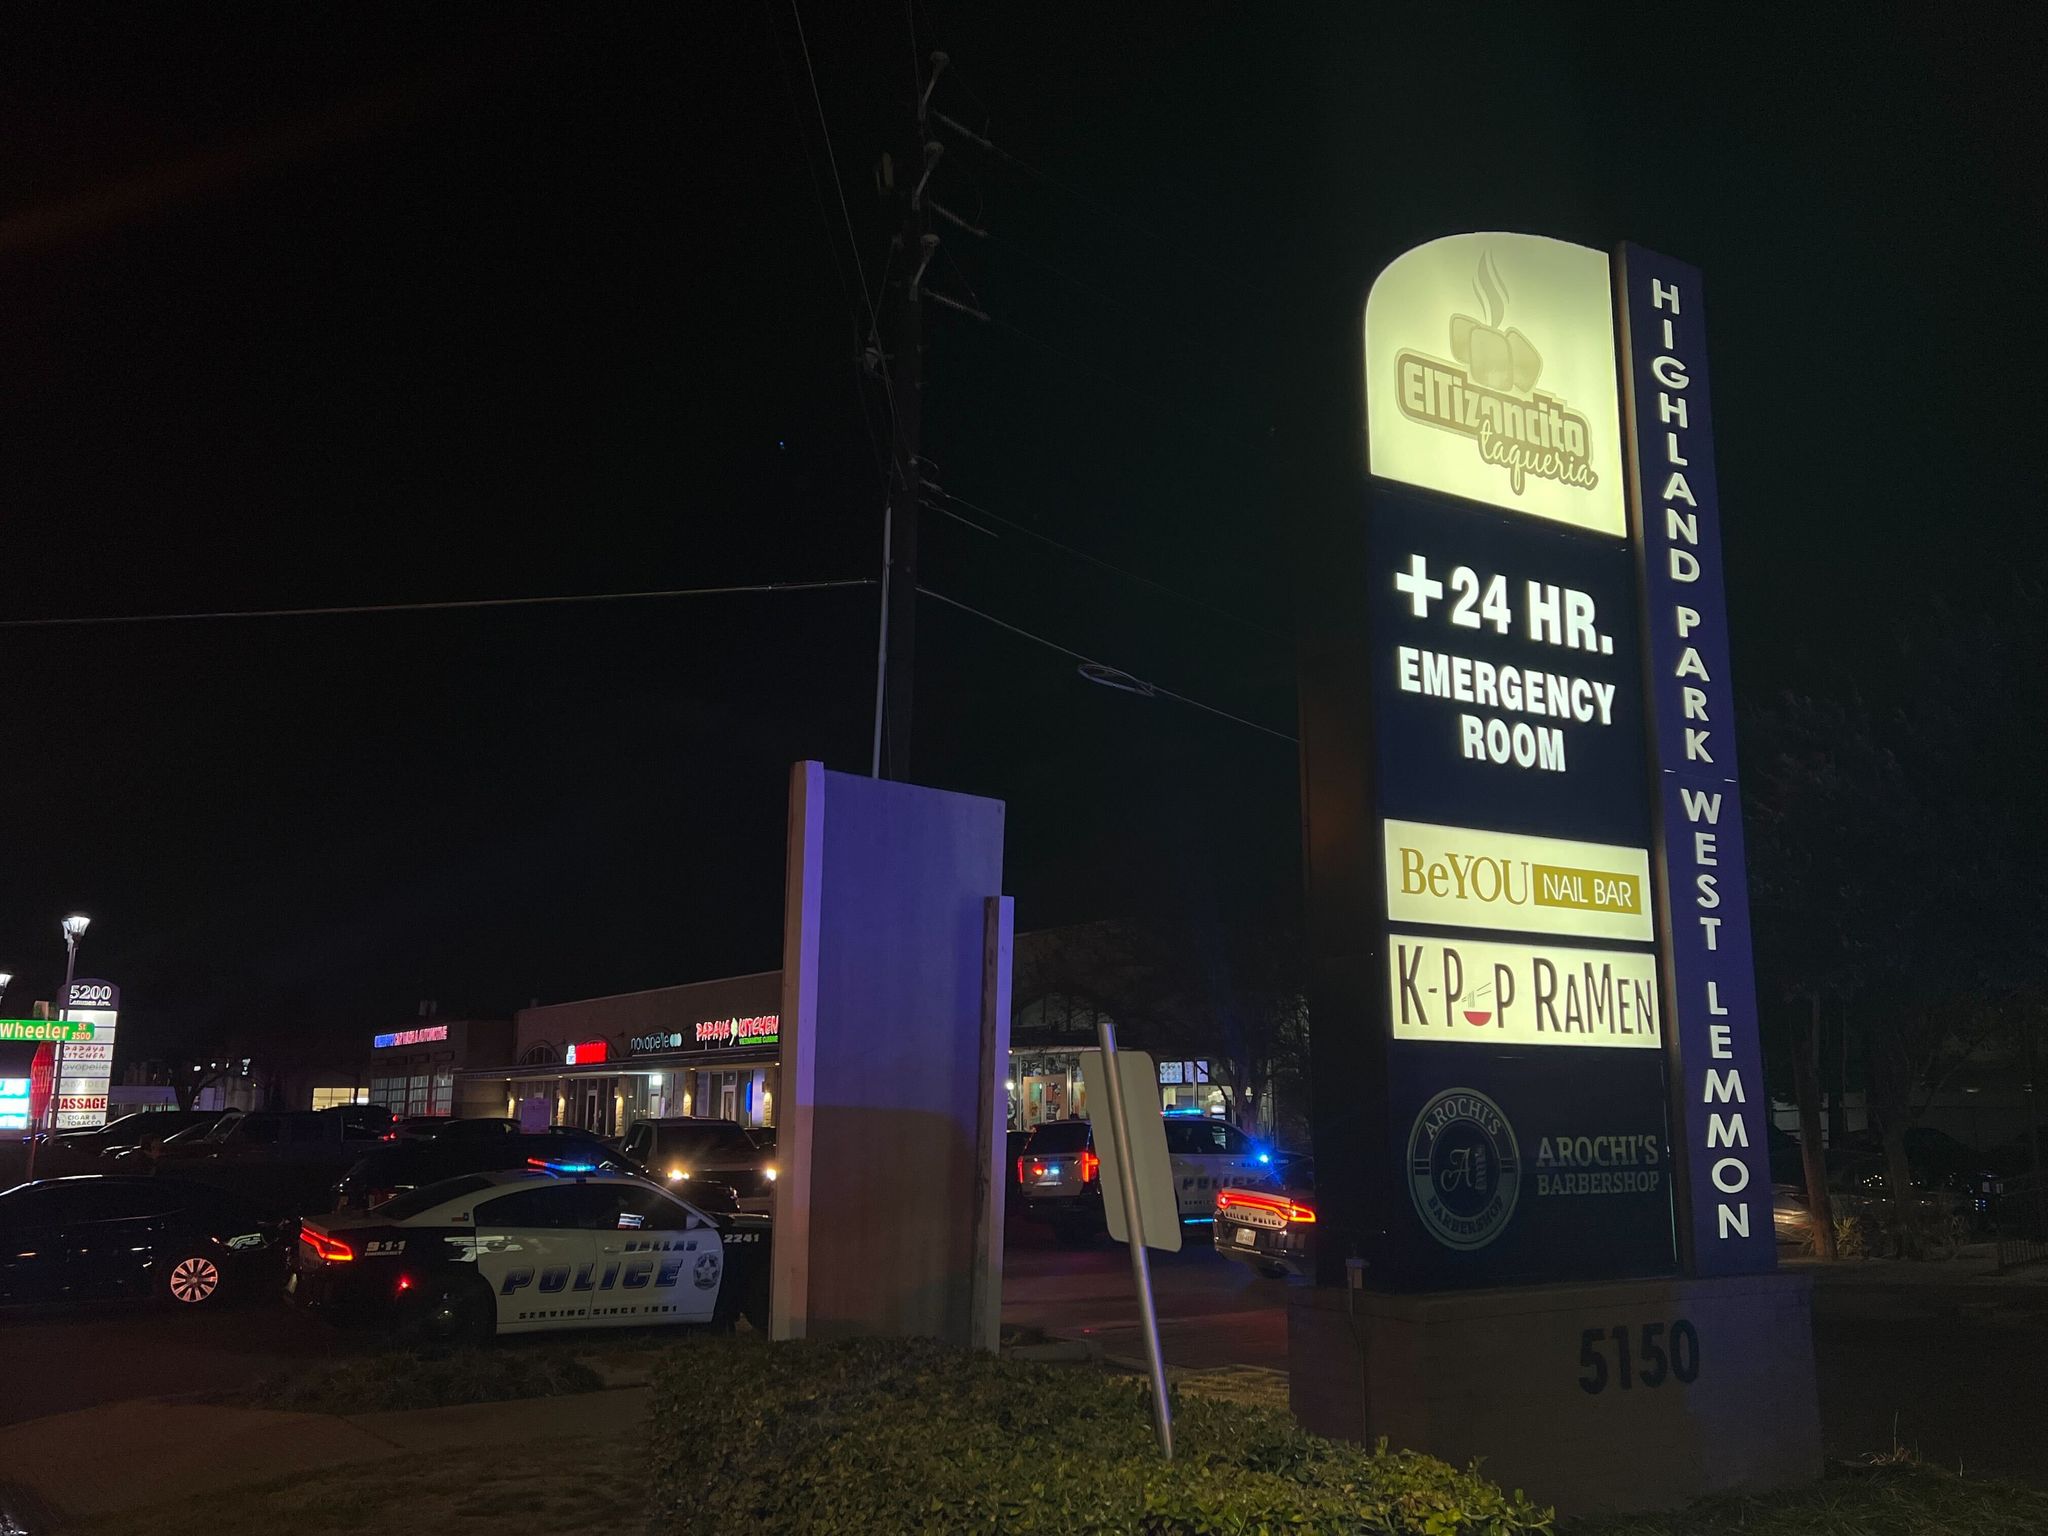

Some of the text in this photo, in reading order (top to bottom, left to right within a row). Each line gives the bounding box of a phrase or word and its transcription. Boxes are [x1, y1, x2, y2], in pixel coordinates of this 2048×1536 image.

[1480, 419, 1595, 491] taqueria
[1528, 580, 1614, 655] HR.
[1399, 645, 1615, 725] EMERGENCY
[1461, 714, 1566, 772] ROOM
[1652, 277, 1750, 1239] HIGHLAND PARK WEST LEMMON
[1400, 847, 1632, 908] BeYOU NAIL BAR
[69, 985, 112, 999] 5200
[0, 1022, 69, 1039] Wheeler
[72, 1032, 91, 1040] 3500
[696, 1020, 731, 1041] PAPAYA
[738, 1015, 779, 1037] KITCHEN
[631, 1032, 669, 1051] novopelle
[62, 1063, 109, 1072] ovopelle
[60, 1098, 106, 1110] ASSAGE
[1424, 1098, 1501, 1141] AROCHI'S
[1536, 1134, 1660, 1168] AROCHI'S
[1536, 1170, 1660, 1197] BARBERSHOP
[1252, 1218, 1282, 1226] POLICE
[625, 1240, 698, 1251] DALLAS
[724, 1234, 760, 1243] 2241
[500, 1259, 684, 1296] POLICE
[519, 1309, 586, 1319] SERVING
[593, 1305, 637, 1315] SINCE
[1578, 1319, 1700, 1395] 5150
